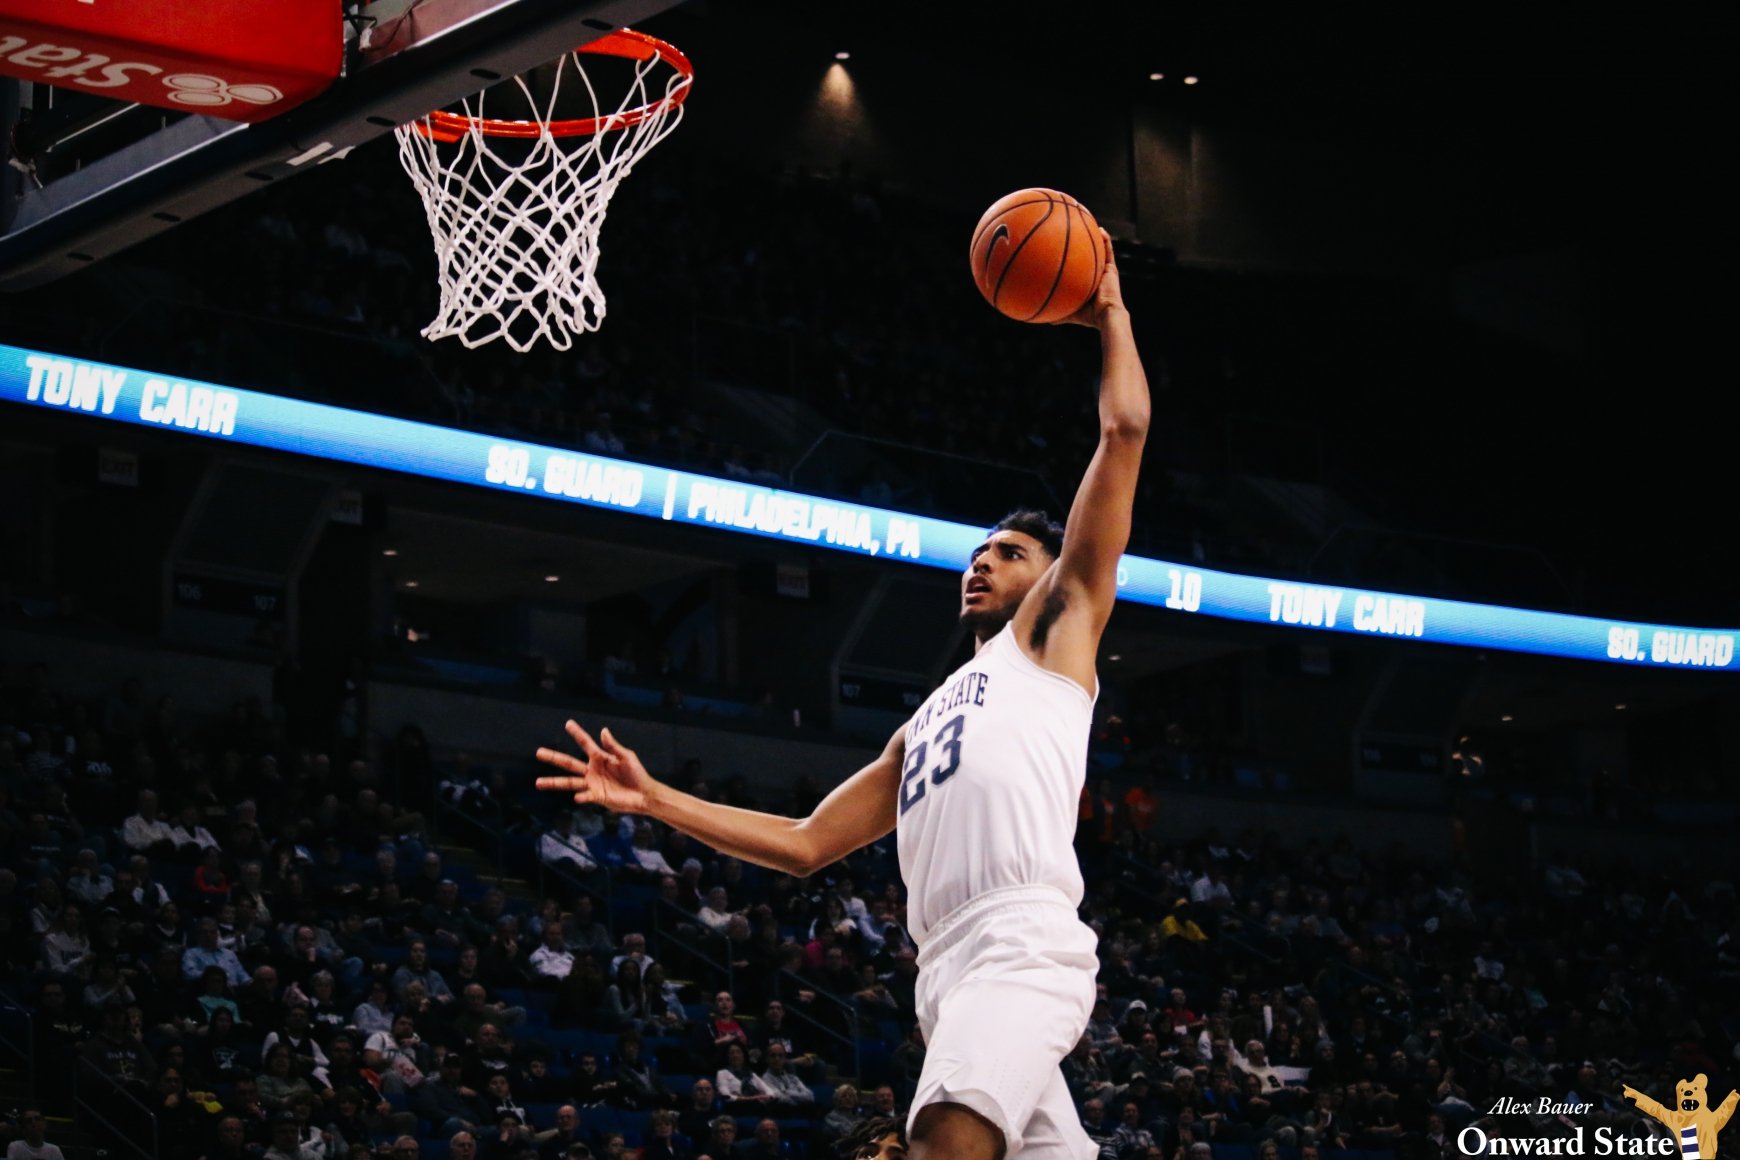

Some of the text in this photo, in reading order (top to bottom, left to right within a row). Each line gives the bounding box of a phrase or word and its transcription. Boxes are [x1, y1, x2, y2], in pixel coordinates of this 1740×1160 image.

[26, 356, 239, 436] TONY CARR
[485, 444, 644, 507] SO. GUARD
[687, 482, 921, 559] PHILADELPHIA, PA
[1165, 569, 1203, 612] 10
[1267, 584, 1342, 628] TONY
[1353, 595, 1425, 637] CARR
[1606, 626, 1734, 667] SO. GUARD
[936, 671, 989, 717] STATE
[900, 714, 965, 817] 23
